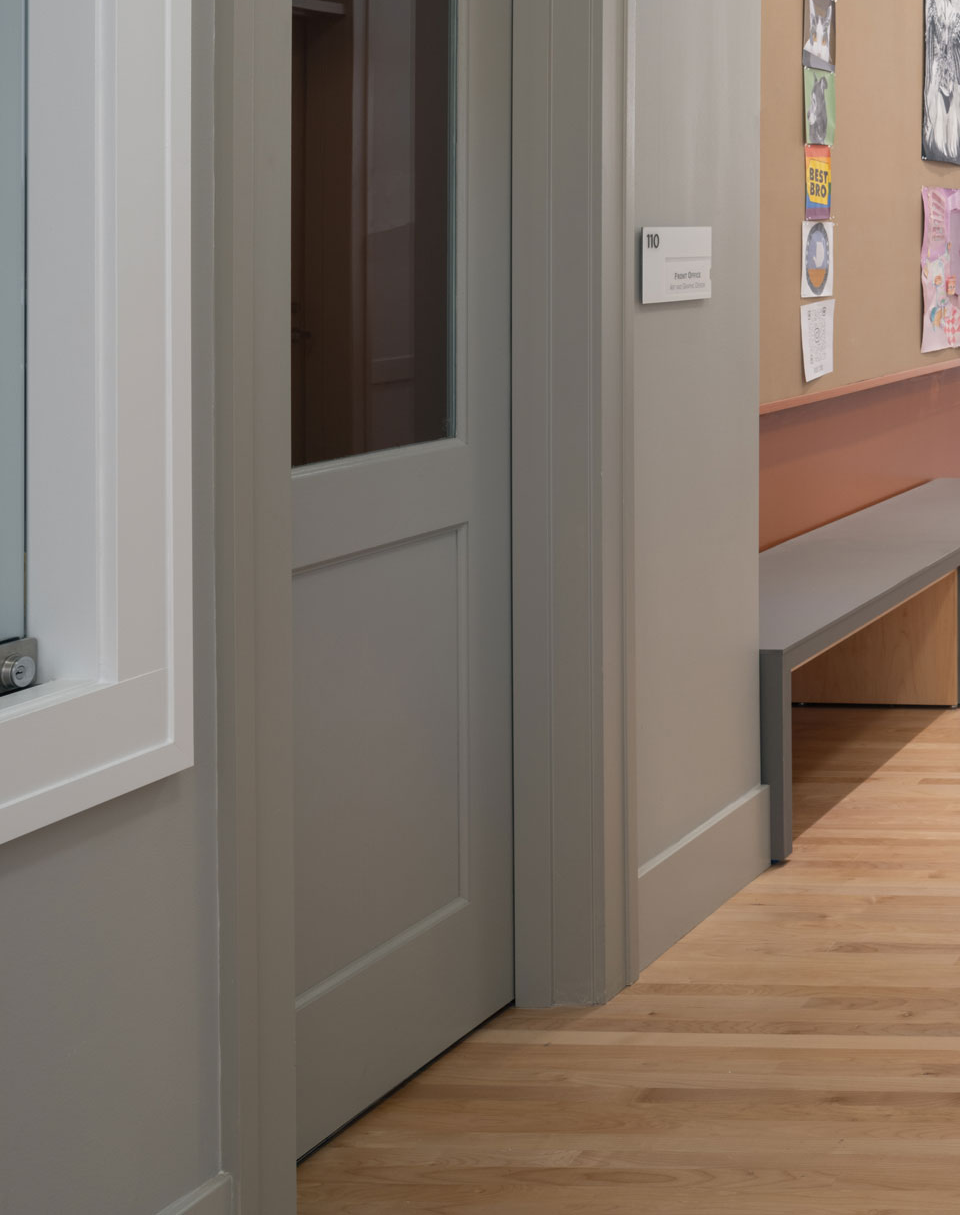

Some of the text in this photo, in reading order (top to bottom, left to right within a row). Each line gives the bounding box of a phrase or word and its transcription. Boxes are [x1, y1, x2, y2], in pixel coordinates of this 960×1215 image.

[809, 167, 828, 184] BEST
[810, 182, 827, 198] BRO
[646, 233, 660, 249] 110
